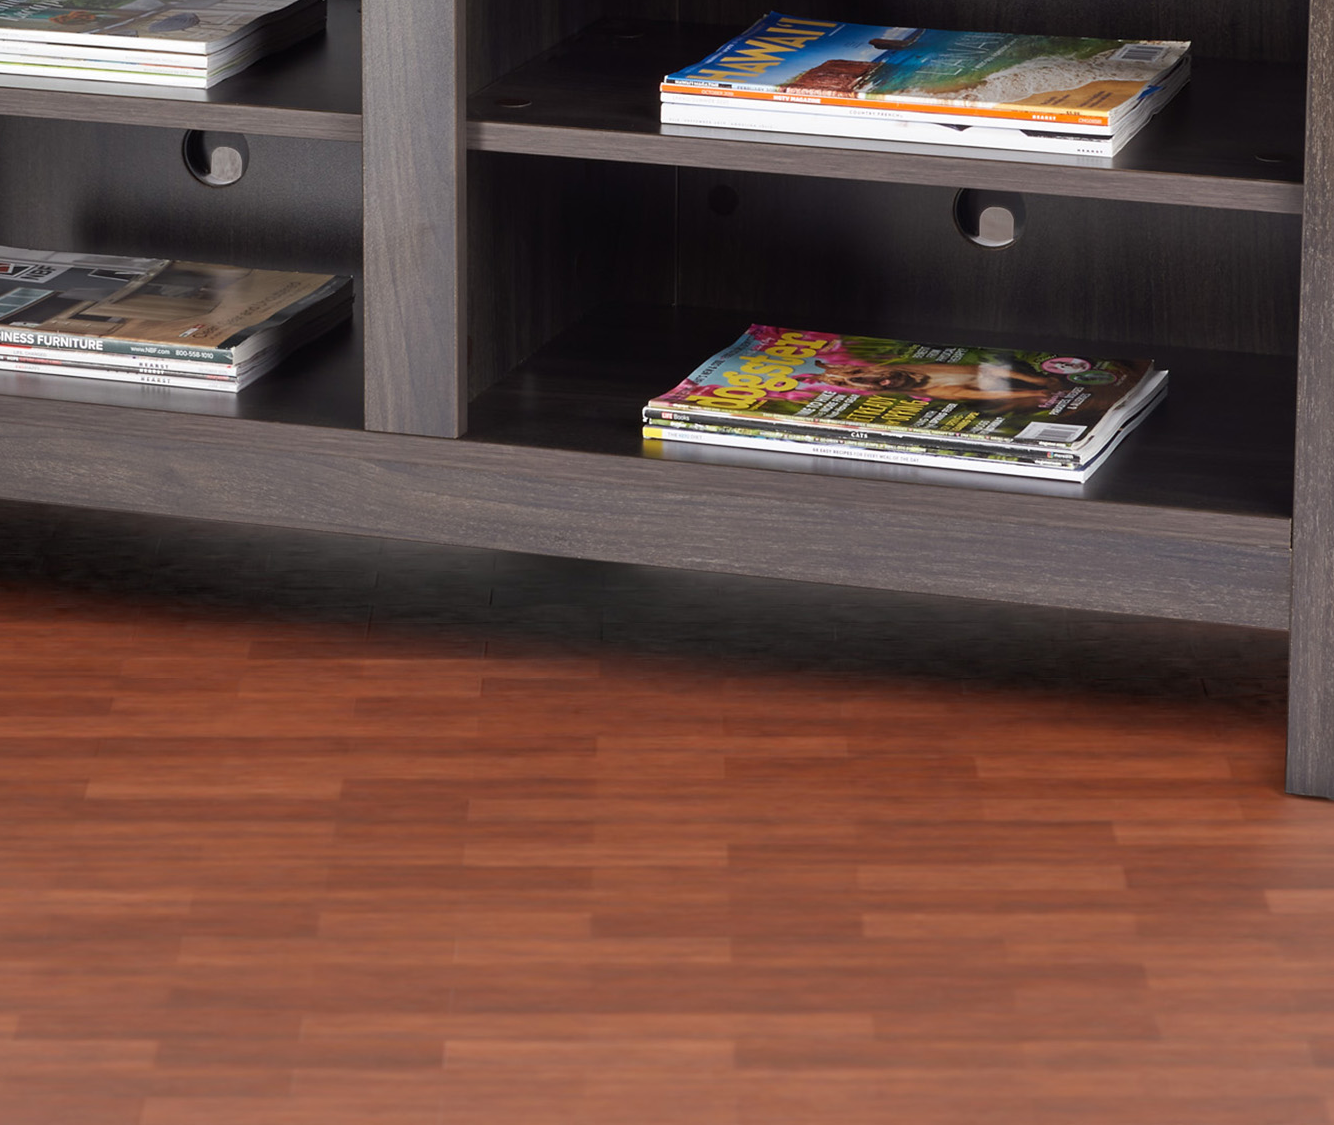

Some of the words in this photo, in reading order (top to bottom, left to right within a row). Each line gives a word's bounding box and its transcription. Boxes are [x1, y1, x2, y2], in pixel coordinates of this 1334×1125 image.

[37, 334, 103, 351] FURNITURE
[130, 346, 170, 355] www.NBF.com
[175, 350, 214, 359] 800-558-1010
[139, 362, 169, 370] HEARST
[685, 332, 828, 411] dogster
[853, 394, 897, 416] READY
[881, 400, 929, 421] SPRING
[661, 411, 673, 419] LIFE
[673, 413, 690, 421] Books
